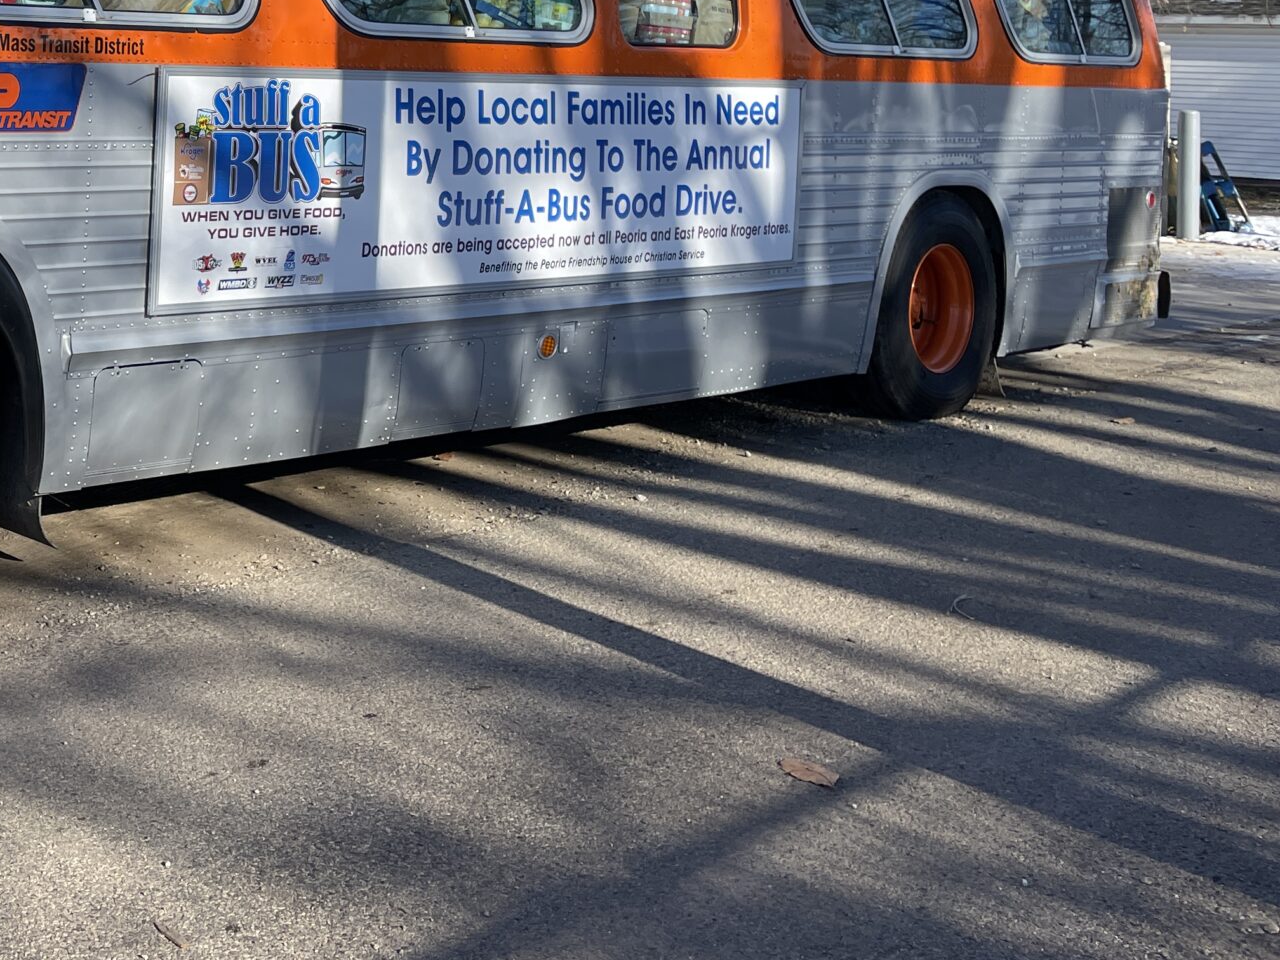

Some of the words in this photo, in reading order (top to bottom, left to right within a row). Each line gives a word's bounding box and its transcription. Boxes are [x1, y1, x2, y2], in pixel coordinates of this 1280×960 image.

[40, 35, 90, 54] Transit
[94, 37, 145, 55] District
[213, 79, 291, 128] stuff
[300, 93, 320, 128] a
[395, 87, 466, 132] Help
[478, 89, 556, 125] Local
[567, 91, 675, 126] Families
[685, 93, 706, 125] In
[716, 94, 779, 126] Need
[210, 130, 320, 204] BUS
[406, 140, 441, 184] By
[452, 140, 586, 182] Donating
[596, 139, 624, 173] To
[633, 139, 678, 172] The
[685, 138, 771, 171] Annual
[181, 211, 229, 222] WHEN
[233, 209, 264, 221] YOU
[267, 208, 300, 220] GIVE
[304, 207, 346, 219] FOOD,
[437, 188, 591, 227] Stuff-A-Bus
[601, 185, 666, 220] Food
[675, 184, 743, 217] Drive.
[208, 227, 239, 239] YOU
[242, 226, 276, 238] GIVE
[279, 225, 321, 237] HOPE.
[361, 241, 428, 258] Donations
[432, 242, 453, 254] are
[457, 238, 492, 255] being
[496, 234, 555, 252] accepted
[558, 235, 579, 248] now
[583, 232, 595, 246] at
[598, 230, 611, 244] all
[615, 229, 647, 244] Peoria
[650, 227, 670, 242] and
[674, 226, 695, 241] East
[697, 225, 728, 239] Peoria
[730, 223, 762, 240] Kroger
[763, 221, 791, 235] stores.
[479, 260, 523, 274] Benefiting
[525, 259, 538, 271] the
[540, 257, 566, 270] Peoria
[568, 253, 608, 269] Friendship
[610, 254, 632, 265] House
[634, 253, 643, 263] of
[644, 251, 676, 263] Christian
[678, 249, 705, 260] Service
[220, 279, 246, 289] WMBD
[268, 276, 293, 286] WYZZ
